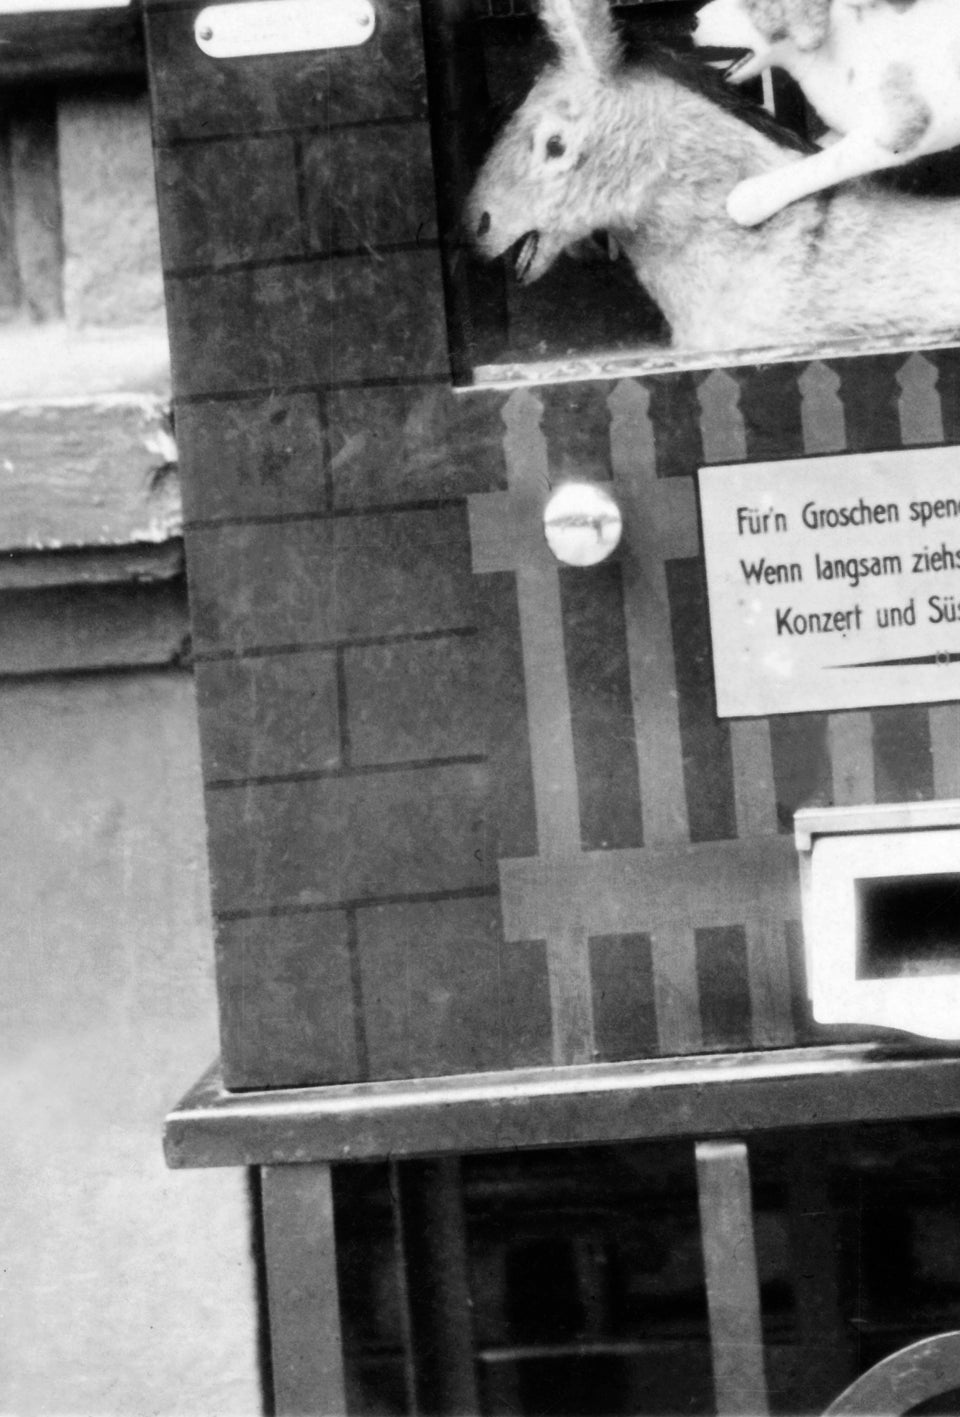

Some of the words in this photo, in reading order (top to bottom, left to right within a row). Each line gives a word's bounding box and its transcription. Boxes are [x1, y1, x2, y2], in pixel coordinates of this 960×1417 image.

[736, 503, 788, 537] Für'n
[801, 498, 900, 530] Groschen
[740, 557, 803, 586] Wenn
[814, 553, 902, 587] langsam
[776, 606, 863, 636] Konzert
[876, 597, 916, 629] und
